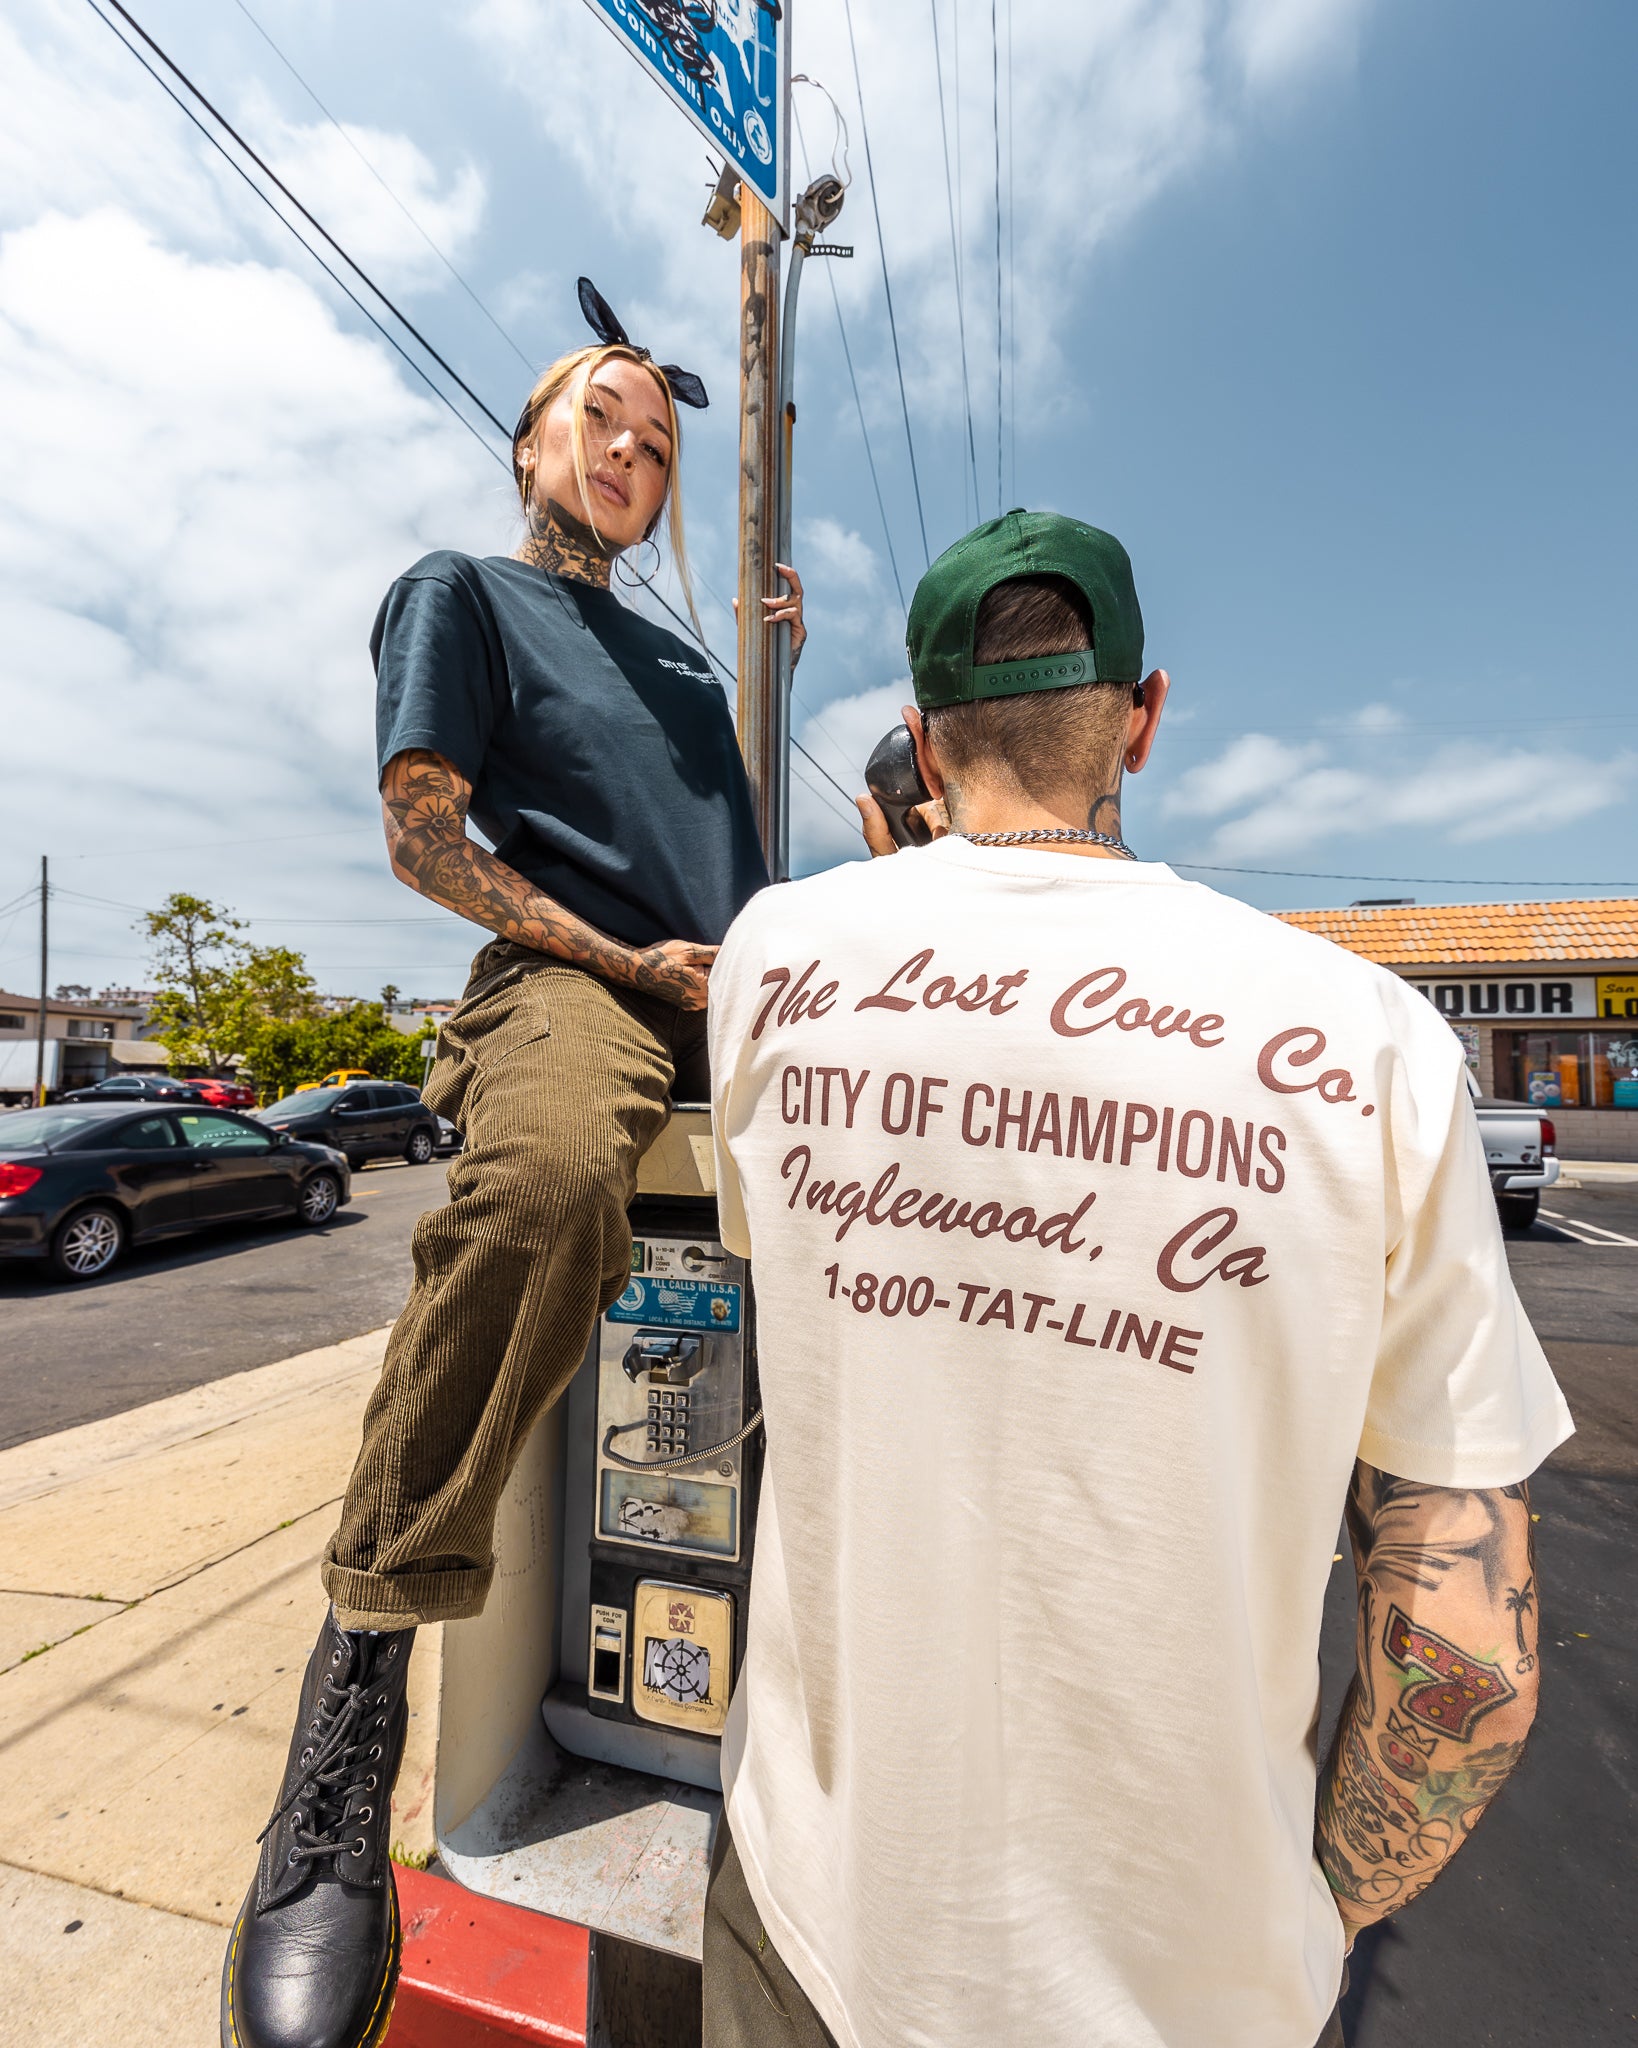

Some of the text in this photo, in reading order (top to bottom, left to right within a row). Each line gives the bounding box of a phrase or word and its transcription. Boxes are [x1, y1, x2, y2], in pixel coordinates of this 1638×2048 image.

[710, 106, 746, 159] Only
[752, 949, 1375, 1117] The Lost Cove Co.
[782, 1066, 1286, 1194] CITY OF CHAMPIONS
[781, 1145, 1270, 1293] Inglewood, Ca
[651, 1279, 736, 1294] ALL CALLS IN U.S.A.
[683, 1318, 707, 1327] DISTANCE
[825, 1263, 1204, 1375] 1-800-TAT-LINE
[595, 1609, 610, 1617] PUSH
